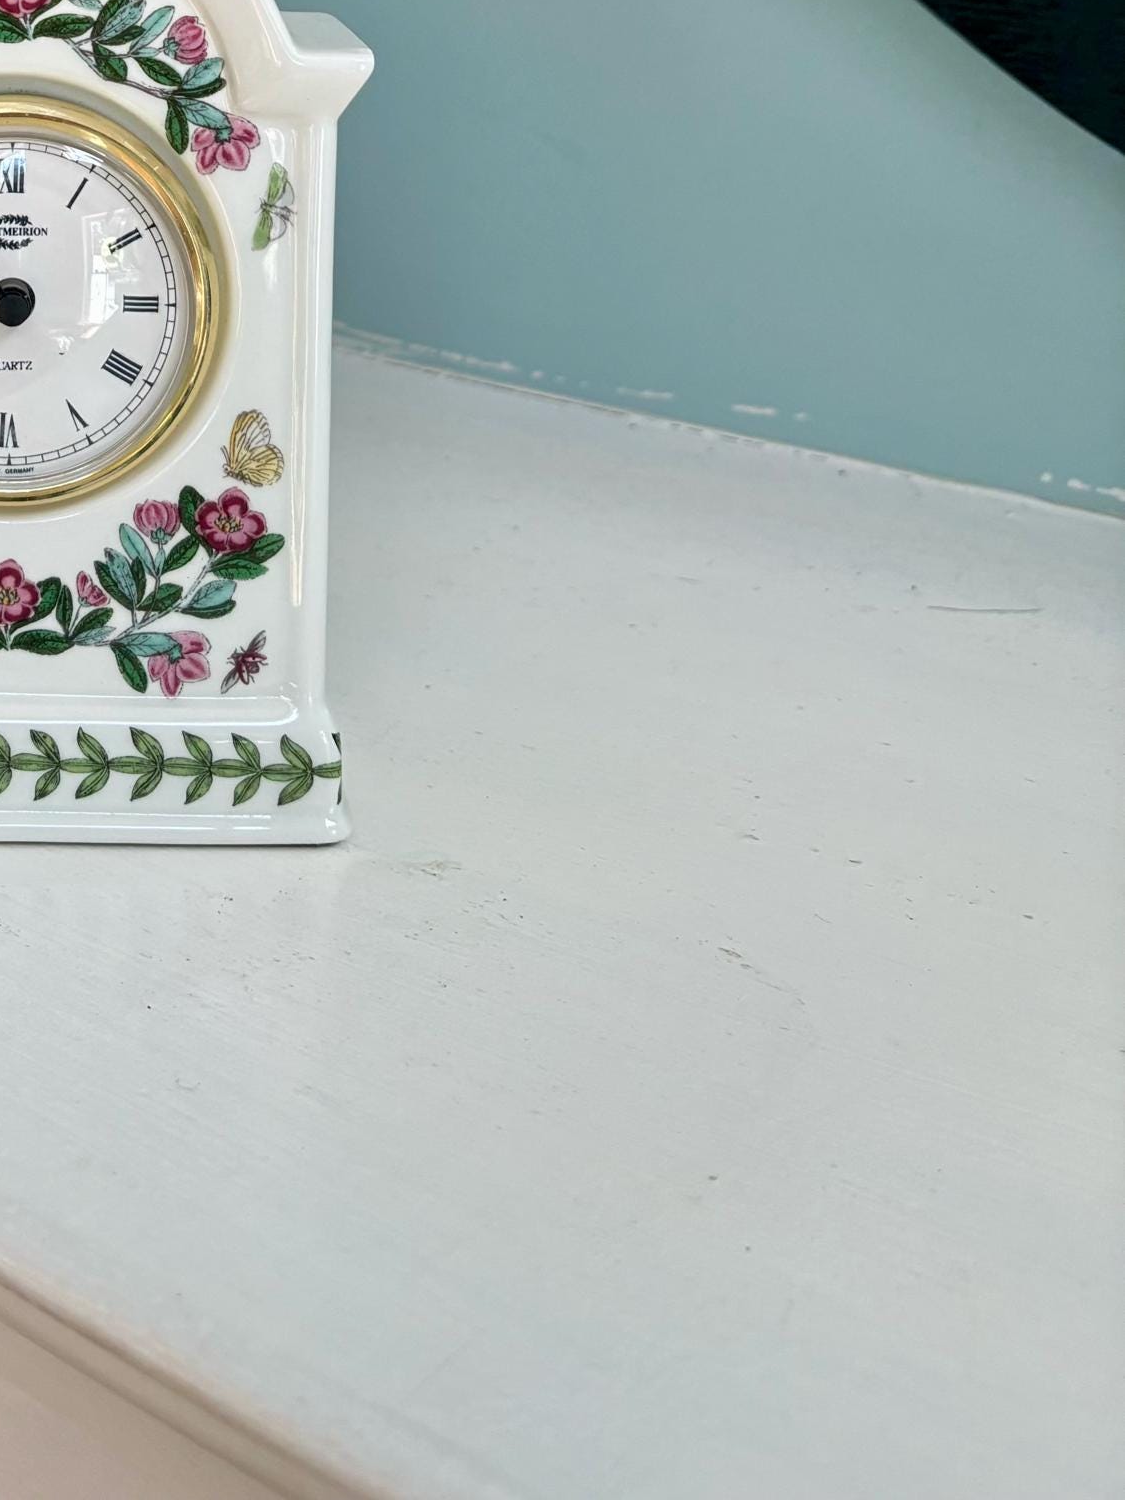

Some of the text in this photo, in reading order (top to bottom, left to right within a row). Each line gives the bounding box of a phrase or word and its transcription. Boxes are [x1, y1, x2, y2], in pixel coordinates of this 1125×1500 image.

[66, 177, 88, 209] I
[108, 228, 143, 254] II
[122, 295, 159, 313] III
[101, 348, 143, 386] IIII
[0, 412, 19, 449] VI
[65, 399, 88, 432] V
